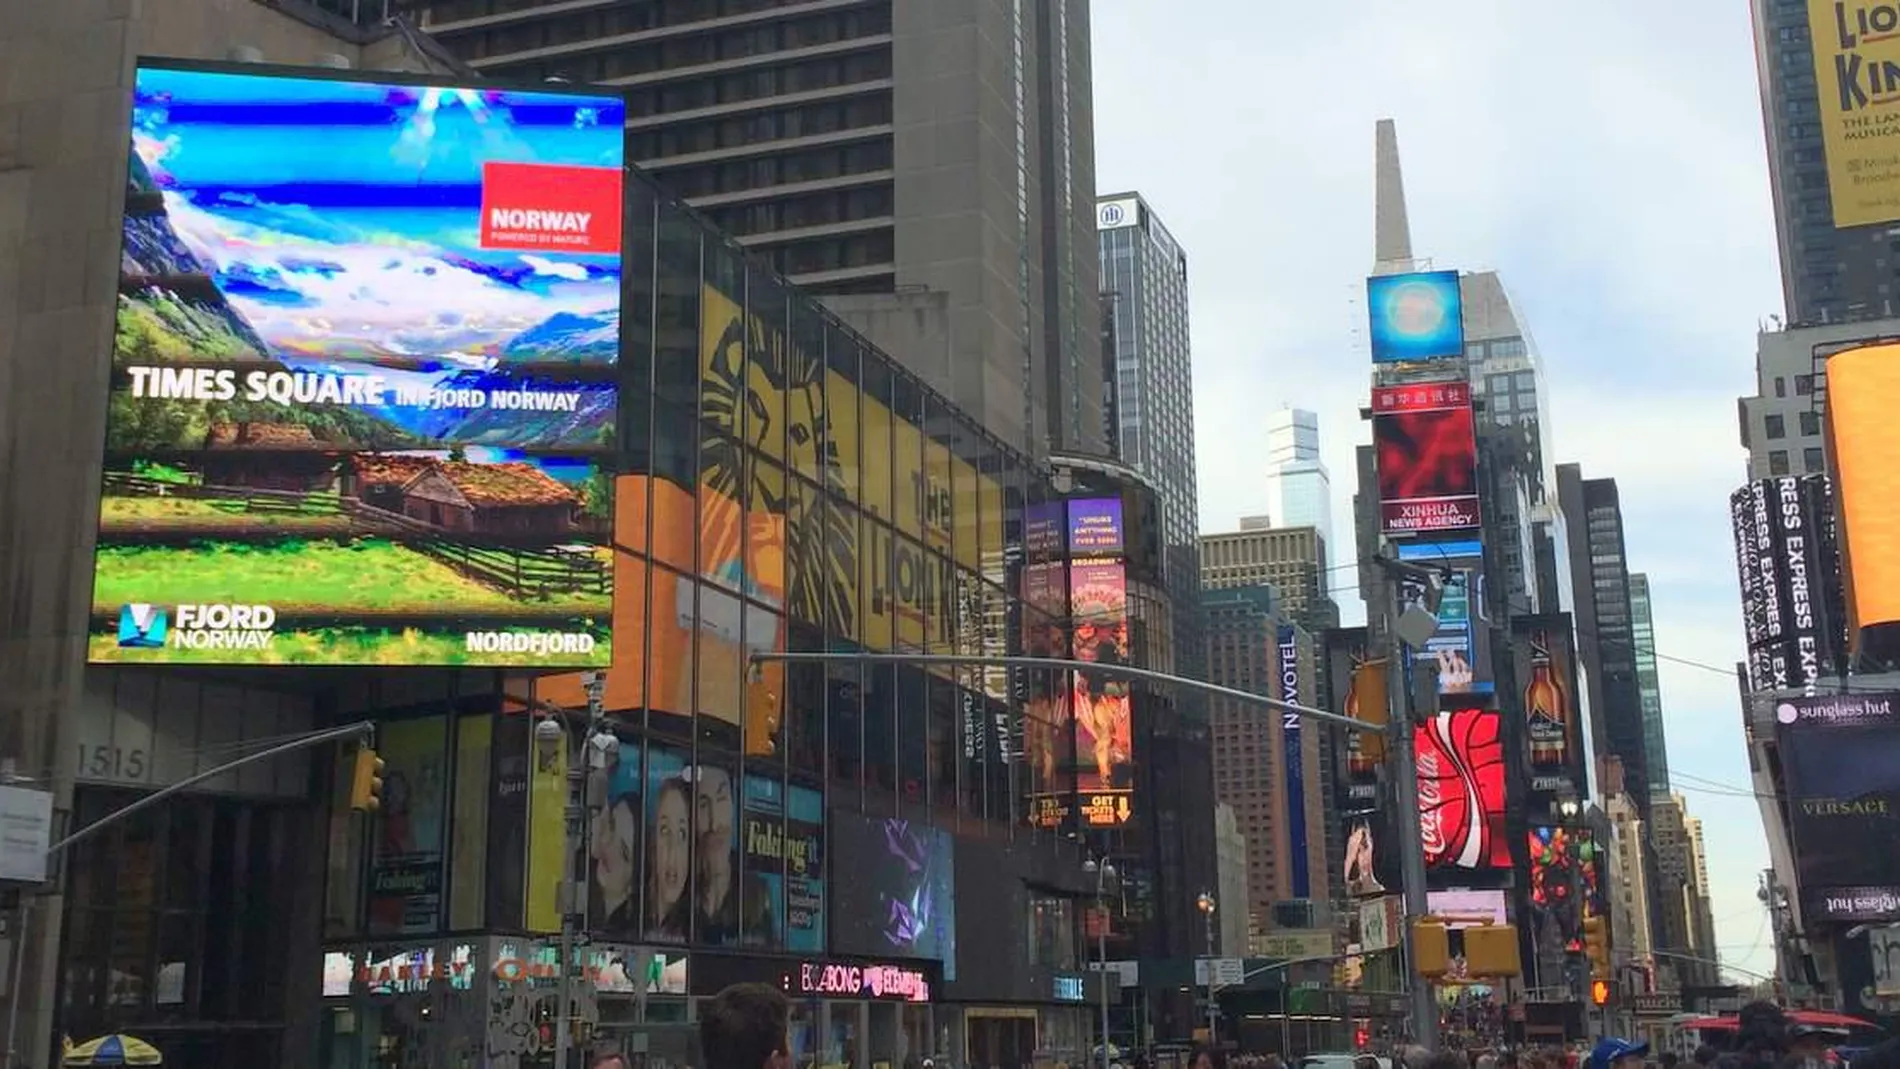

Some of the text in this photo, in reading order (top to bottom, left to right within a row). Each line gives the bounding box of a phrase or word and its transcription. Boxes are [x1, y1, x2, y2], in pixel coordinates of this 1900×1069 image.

[1835, 2, 1900, 48] LIO
[1842, 117, 1871, 130] THE
[491, 208, 592, 232] NORWAY
[491, 232, 590, 245] POWERED BY NATURE
[127, 366, 581, 412] TIMES SQUARE IN FJORD NORWAY
[1389, 514, 1473, 529] NEWS AGENCY
[1401, 503, 1460, 518] XINHUA
[870, 504, 936, 617] LION
[1786, 535, 1814, 630] EXPRESS
[175, 603, 276, 630] FJORD
[174, 629, 274, 650] NORWAY
[466, 631, 595, 656] NORDFJORD
[1799, 700, 1892, 719] sunglass hut
[77, 743, 145, 779] 1515
[1091, 796, 1114, 806] GET
[1803, 801, 1888, 815] VERSACE
[747, 819, 818, 873] Faking it
